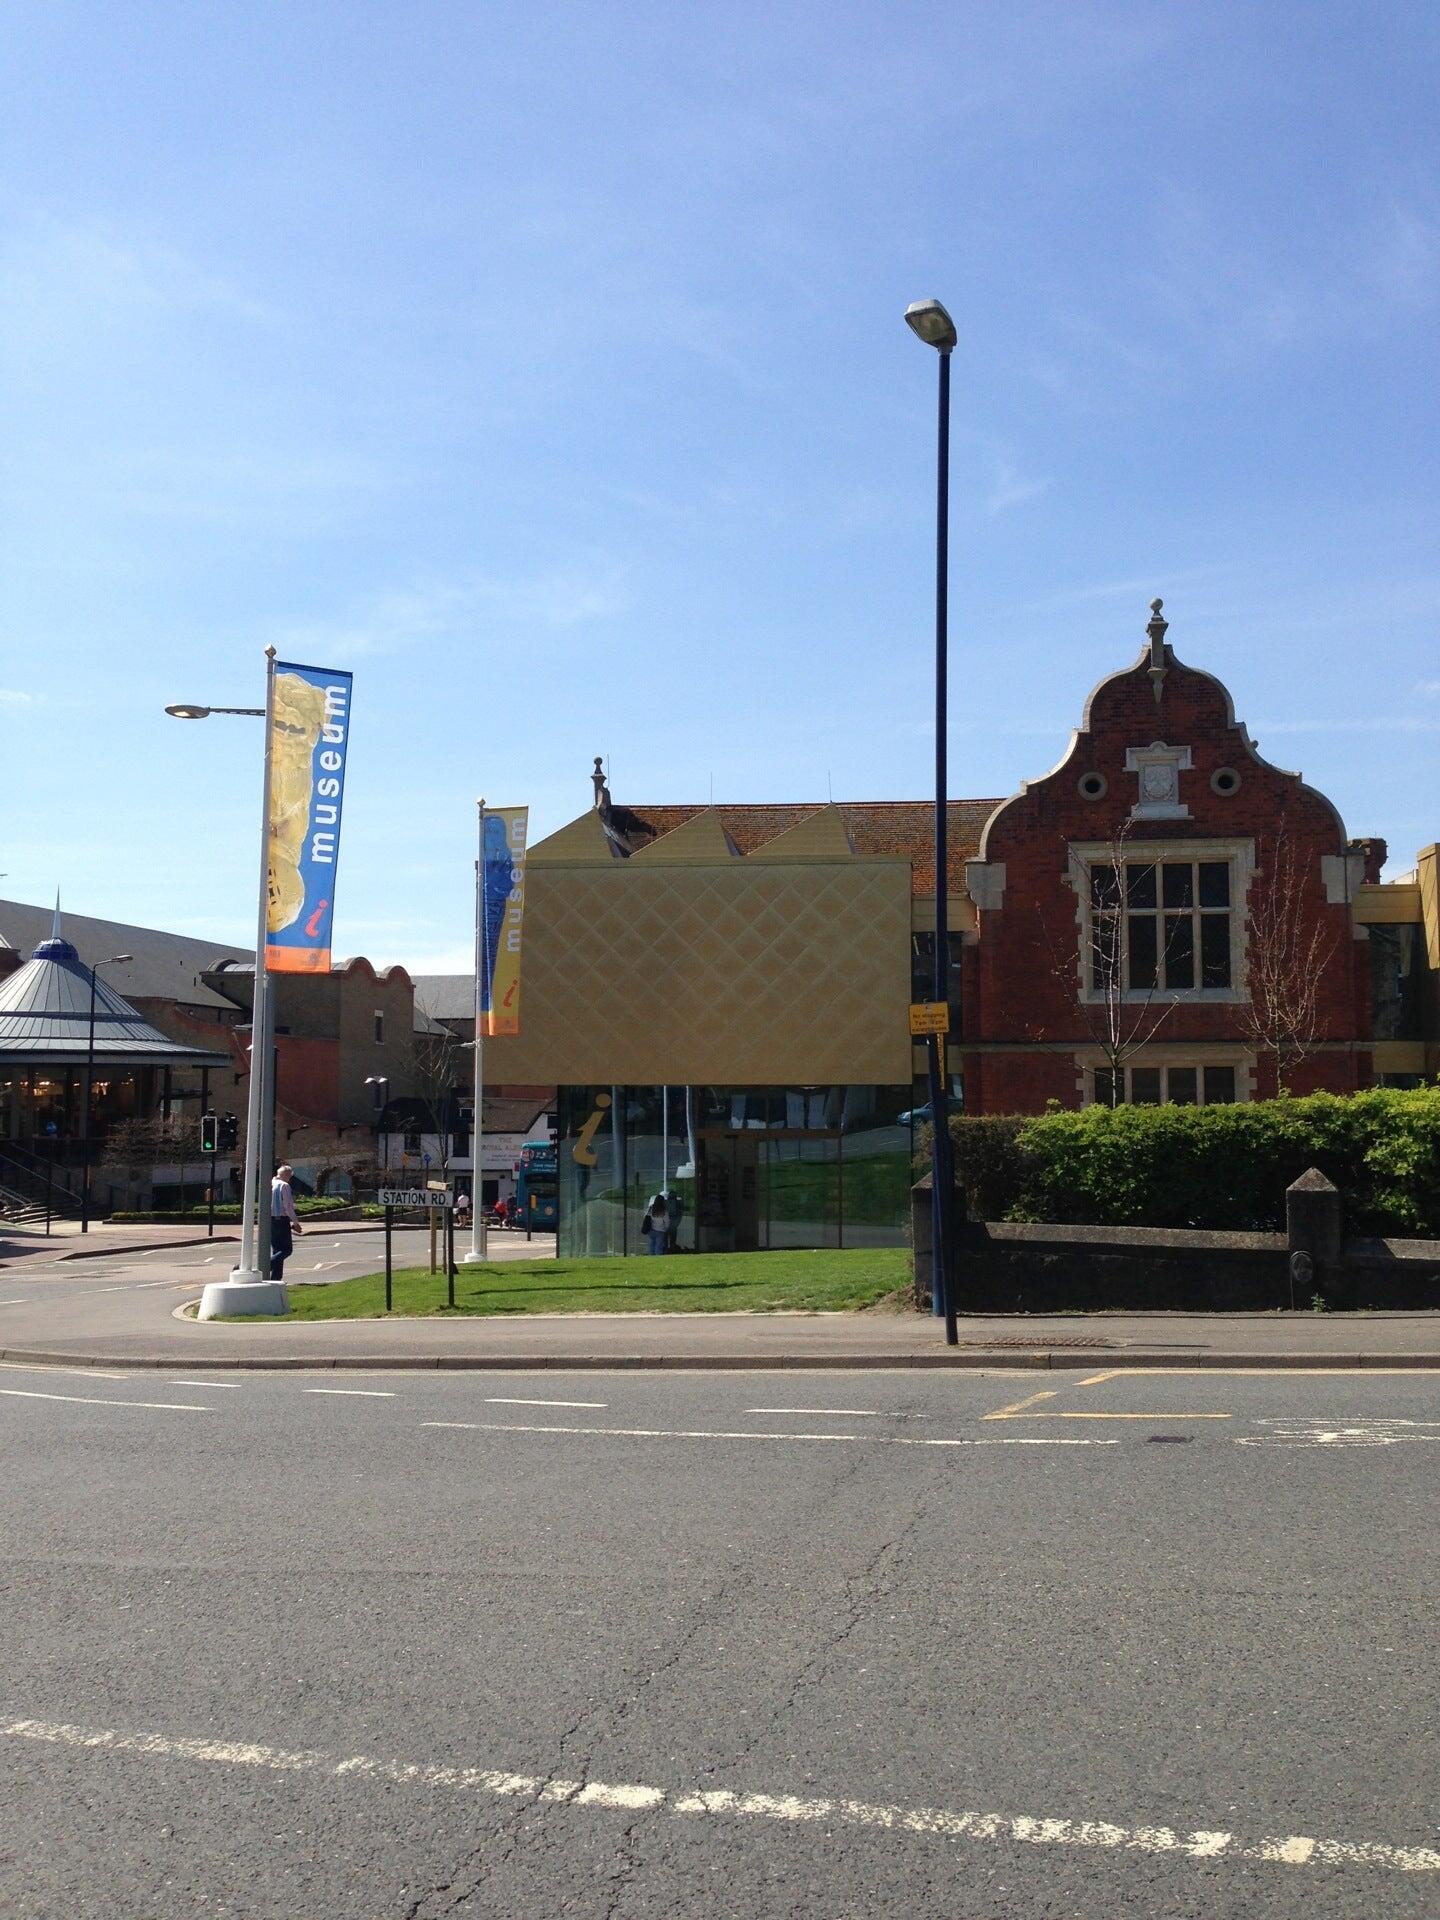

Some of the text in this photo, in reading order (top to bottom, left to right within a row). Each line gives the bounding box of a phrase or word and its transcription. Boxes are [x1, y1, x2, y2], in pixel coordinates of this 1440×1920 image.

[311, 685, 347, 864] museum
[507, 816, 527, 953] museum
[383, 1191, 426, 1205] STATION
